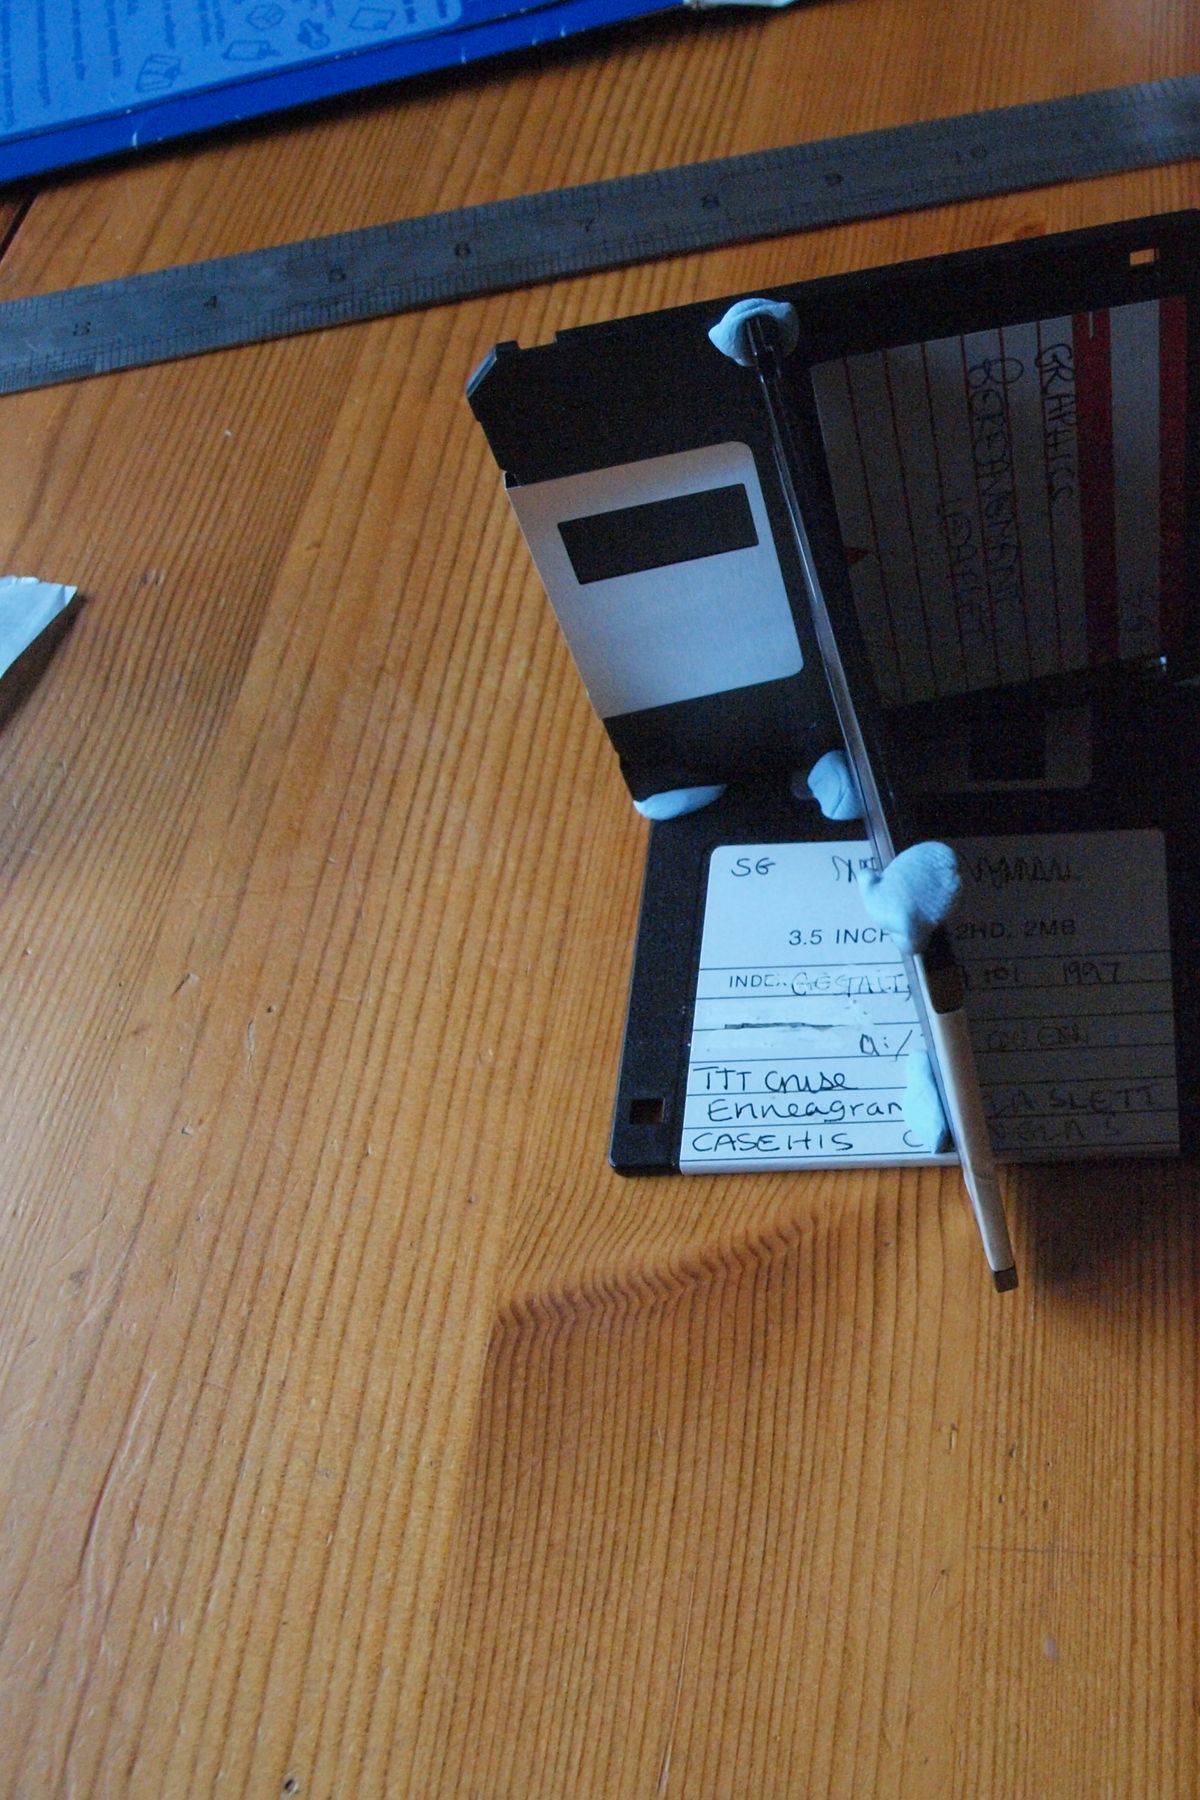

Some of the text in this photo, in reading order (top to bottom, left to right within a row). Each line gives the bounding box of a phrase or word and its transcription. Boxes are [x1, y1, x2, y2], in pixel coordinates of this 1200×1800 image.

[731, 857, 775, 877] SG
[789, 929, 822, 946] 3.5
[1025, 918, 1077, 938] 2MB
[1063, 960, 1121, 985] 1997
